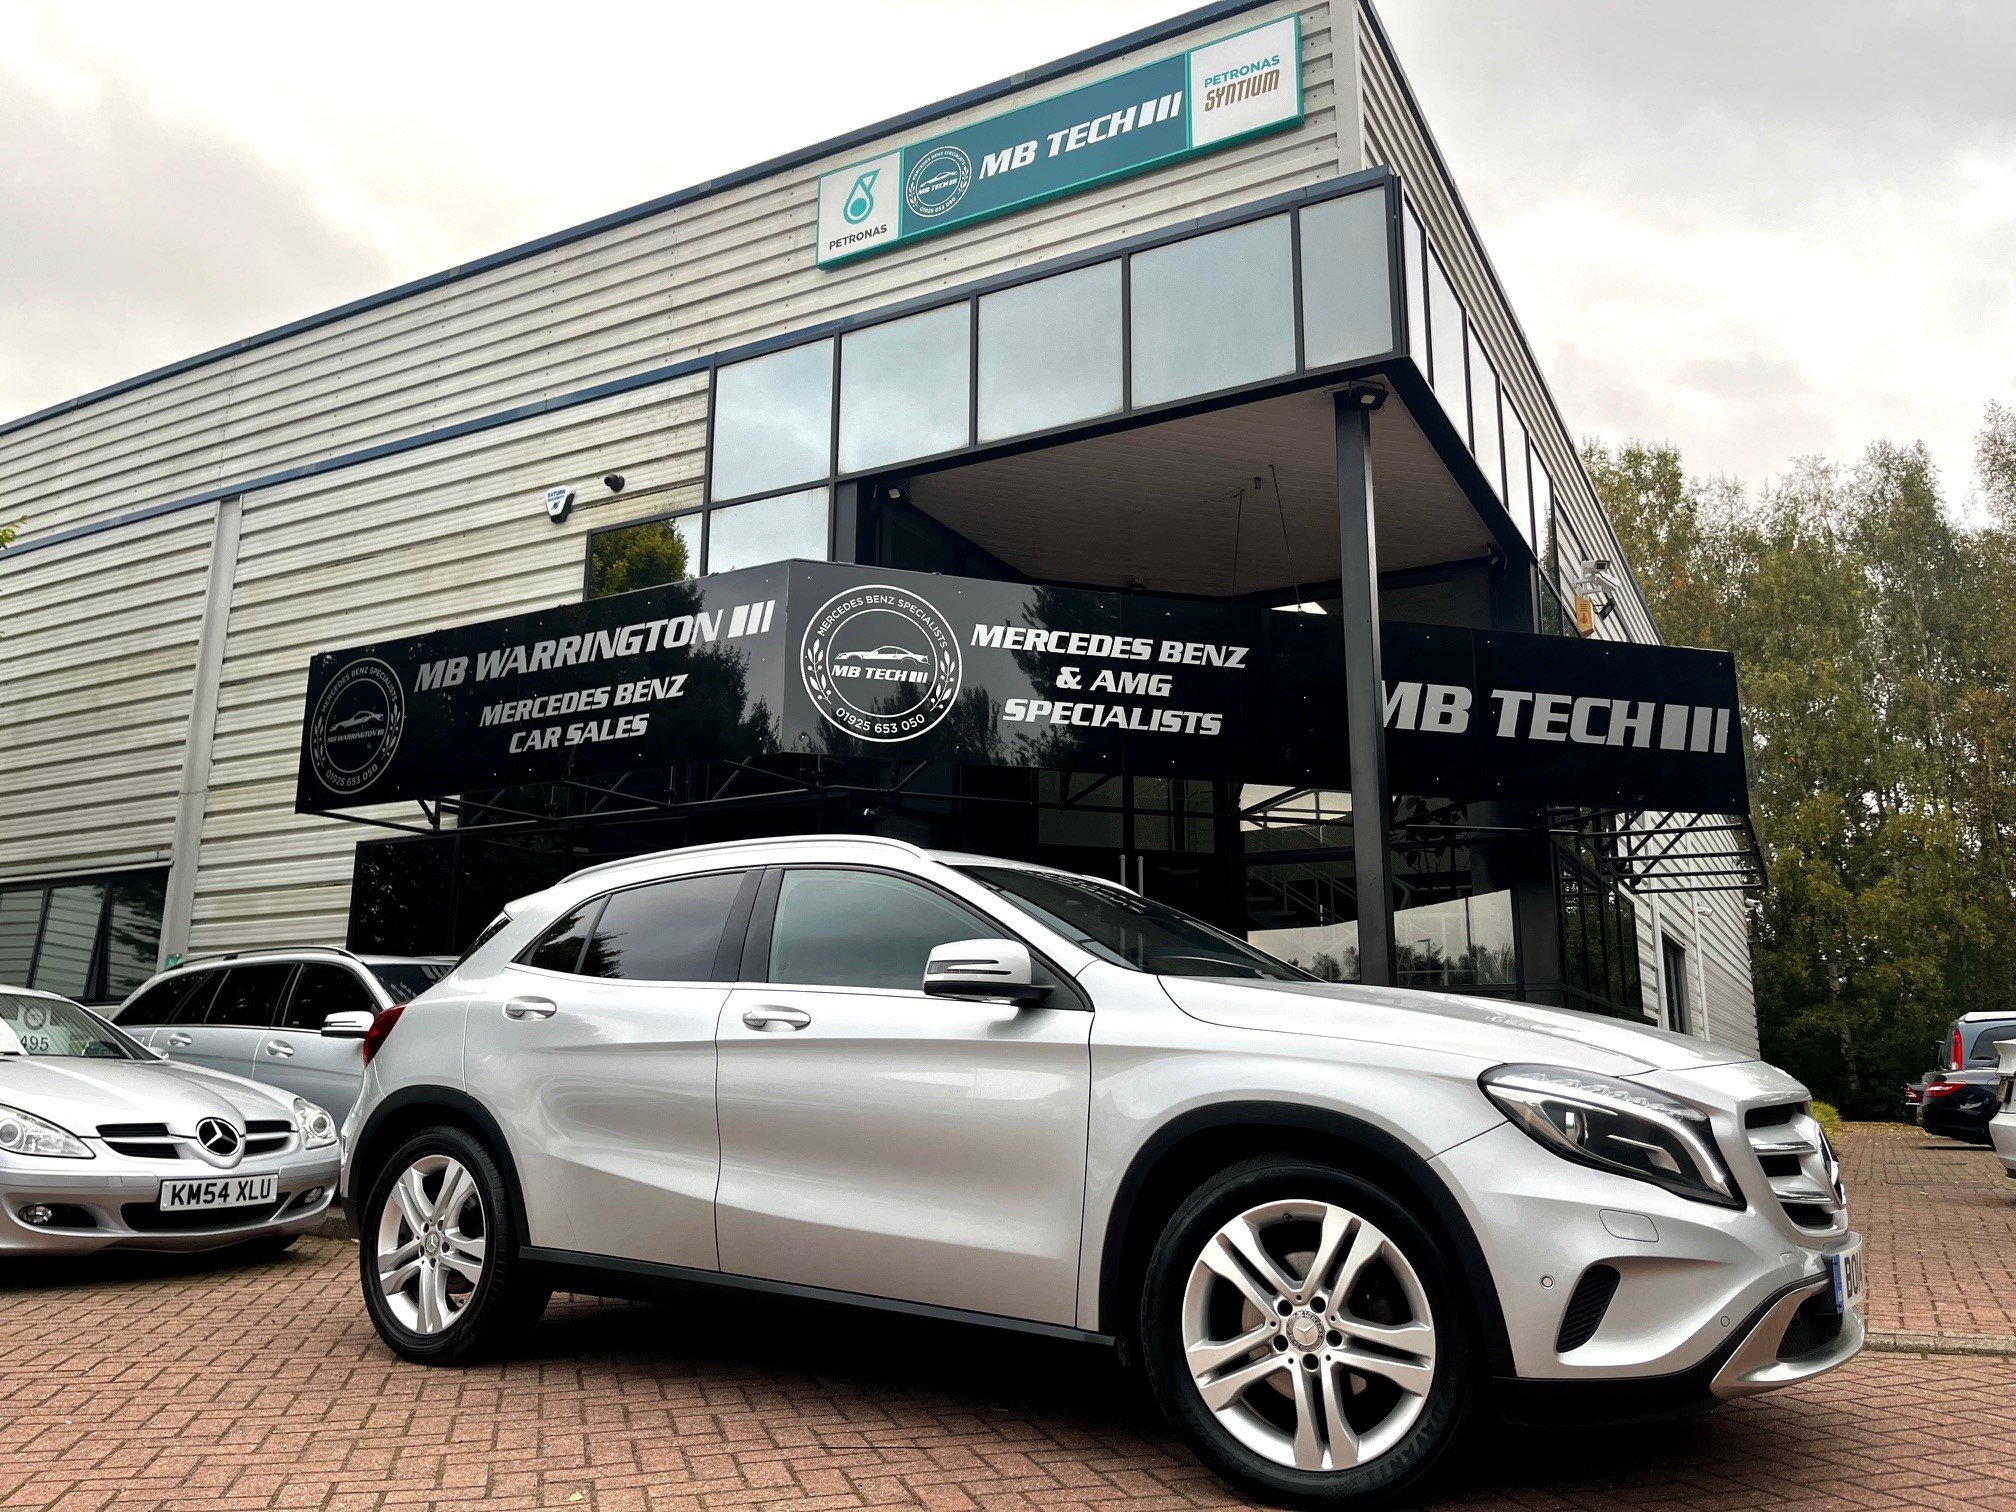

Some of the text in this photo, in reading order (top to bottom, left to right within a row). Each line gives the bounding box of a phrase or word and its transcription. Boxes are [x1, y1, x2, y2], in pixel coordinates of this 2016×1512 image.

[1204, 55, 1280, 88] PETRONAS
[1204, 69, 1280, 112] SYNTIUM
[978, 140, 1038, 180] MB
[1046, 105, 1138, 158] TECH
[829, 224, 888, 250] PETRONAS
[817, 595, 948, 649] MERCEDES BENZ SPECIALISTS
[413, 655, 469, 693] MB
[475, 608, 724, 682] WARRINGTON
[970, 623, 1250, 669] MERCEDES BENZ
[321, 666, 398, 713] MERCEDES BENZ SPECIALISTS
[831, 664, 862, 678] MB
[865, 667, 908, 682] TECH
[1055, 666, 1173, 697] & AMG
[478, 673, 689, 728] MERCEDES BENZ
[836, 707, 925, 734] 01925 653 050
[1002, 698, 1223, 737] SPECIALISTS
[1381, 680, 1473, 734] MB
[1490, 688, 1656, 749] TECH
[509, 713, 650, 754] CAR SALES
[325, 763, 378, 787] 01925 653 050
[170, 1178, 271, 1206] KM54 XLU
